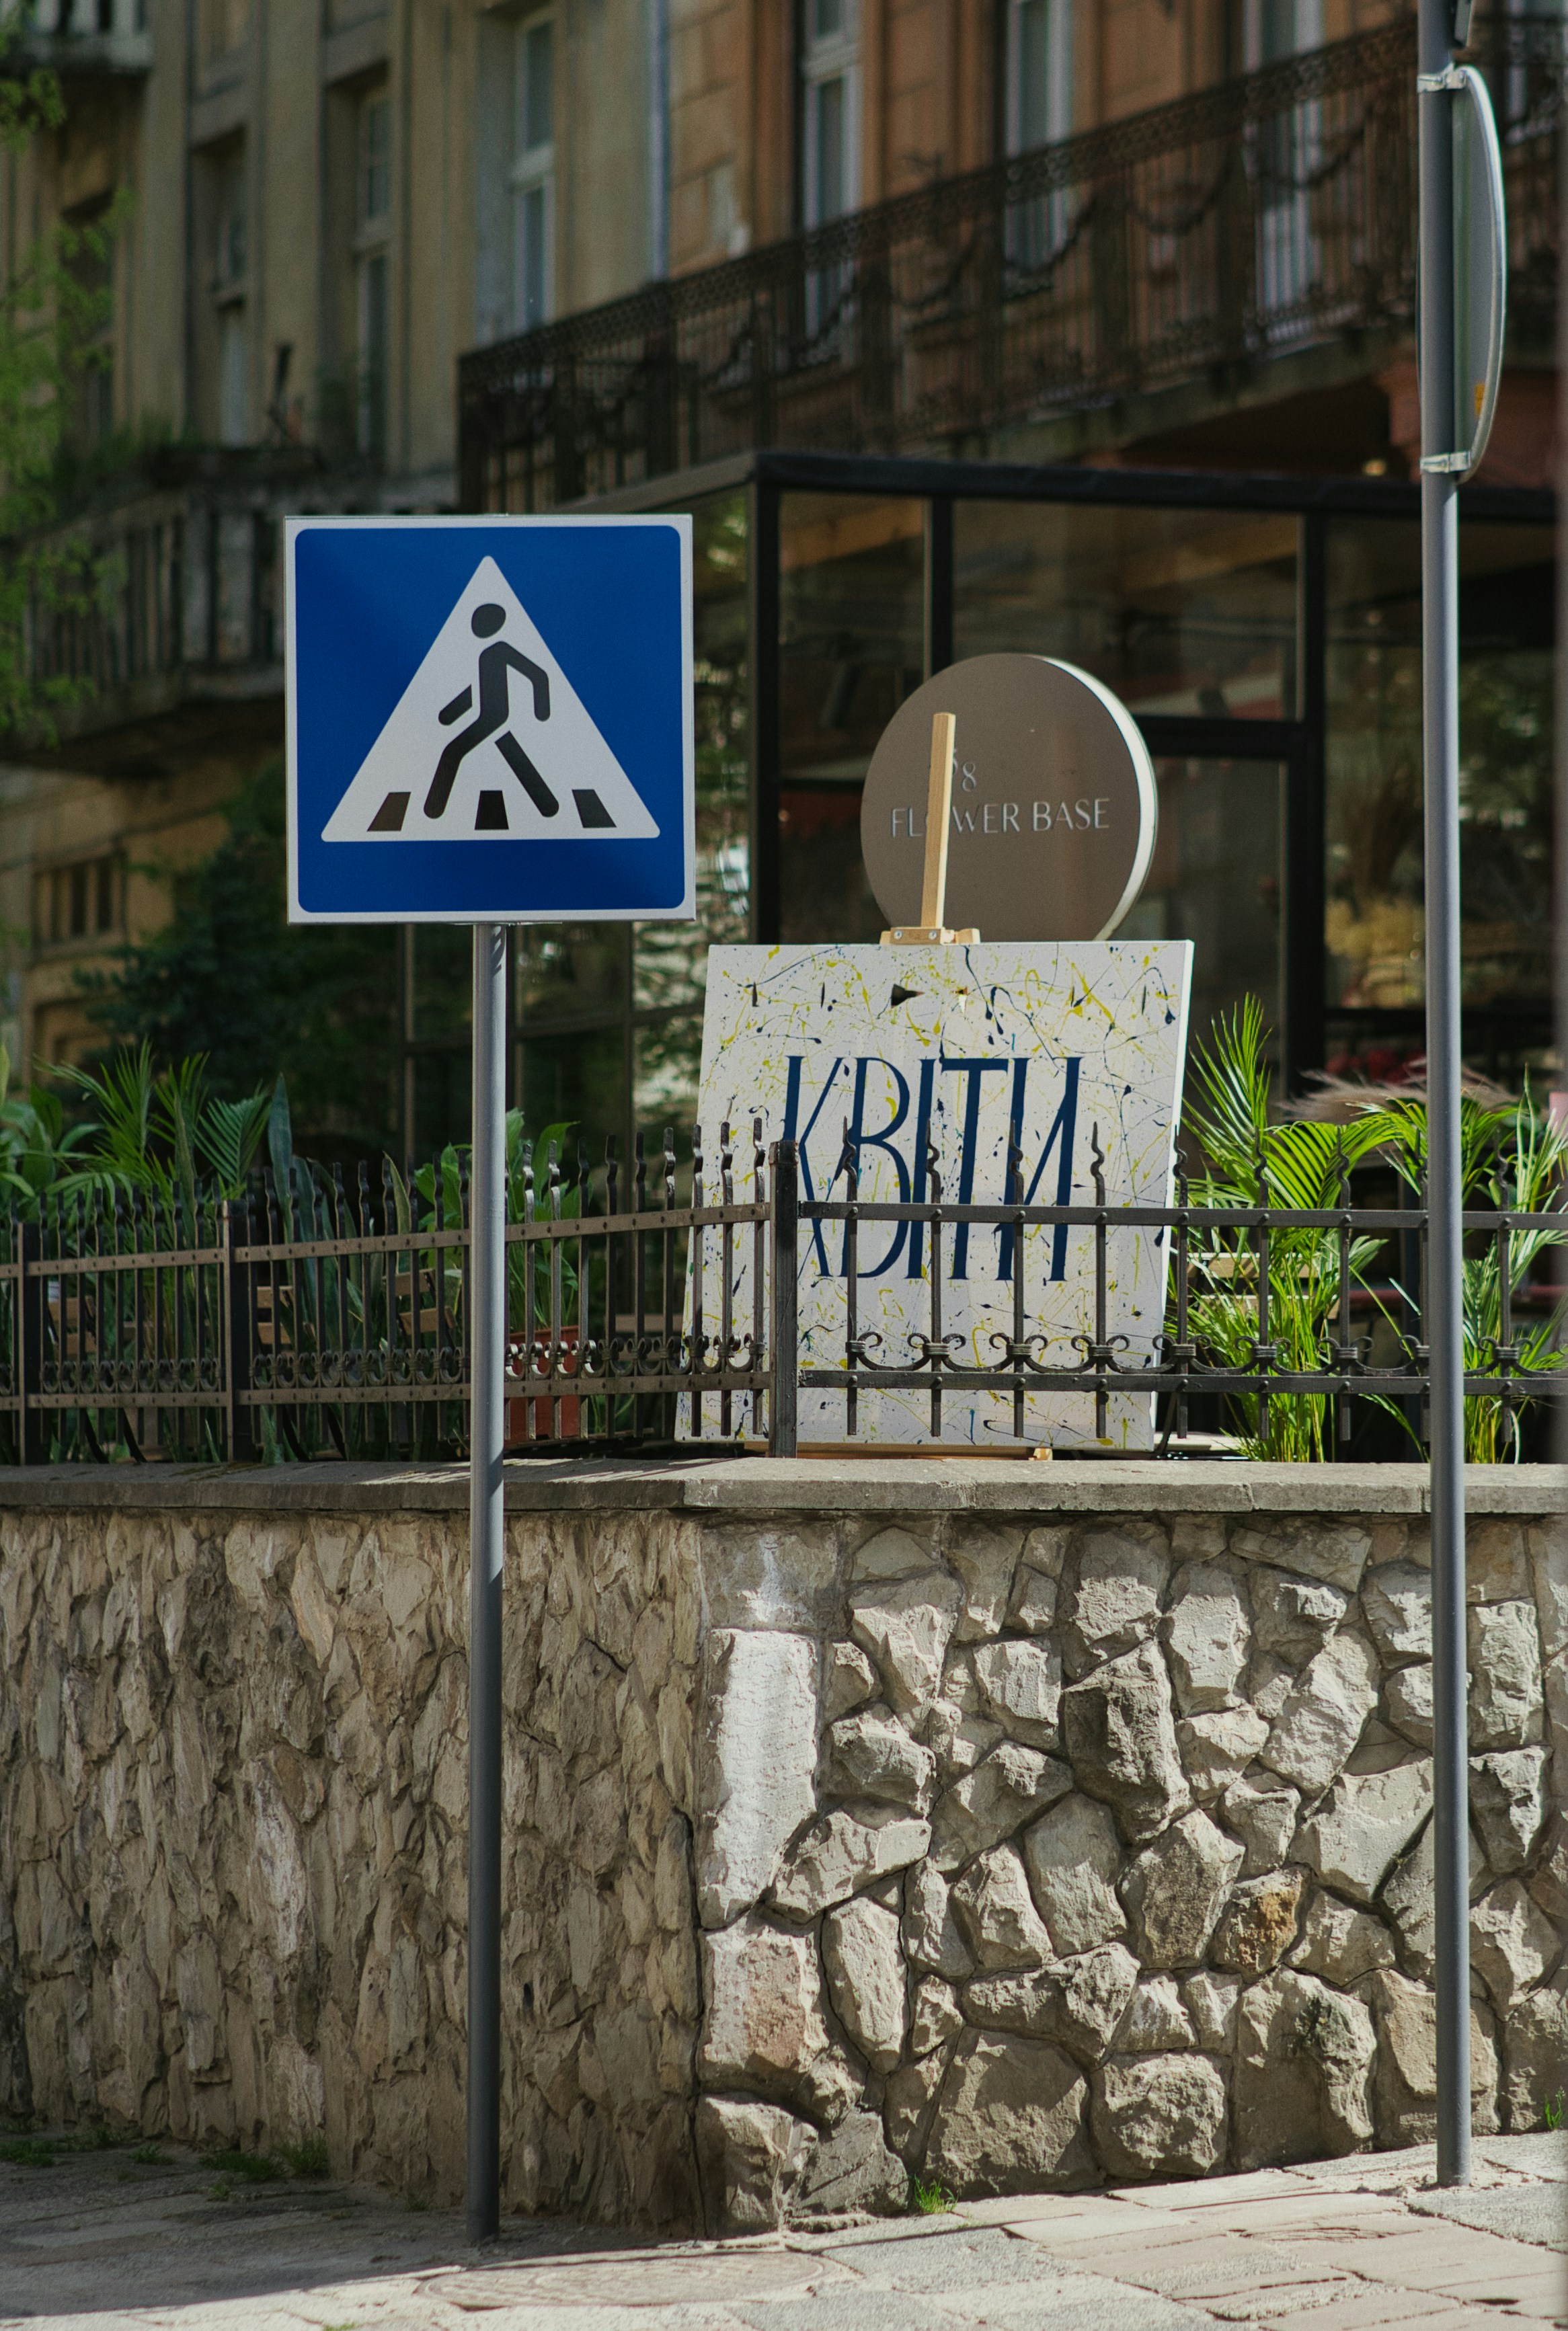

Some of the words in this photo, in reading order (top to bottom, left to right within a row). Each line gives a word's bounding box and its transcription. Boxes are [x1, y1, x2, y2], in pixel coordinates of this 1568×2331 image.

[891, 802, 1021, 838] FLWER
[1032, 797, 1111, 832] BASE
[779, 1055, 1085, 1281] КВІТИ
